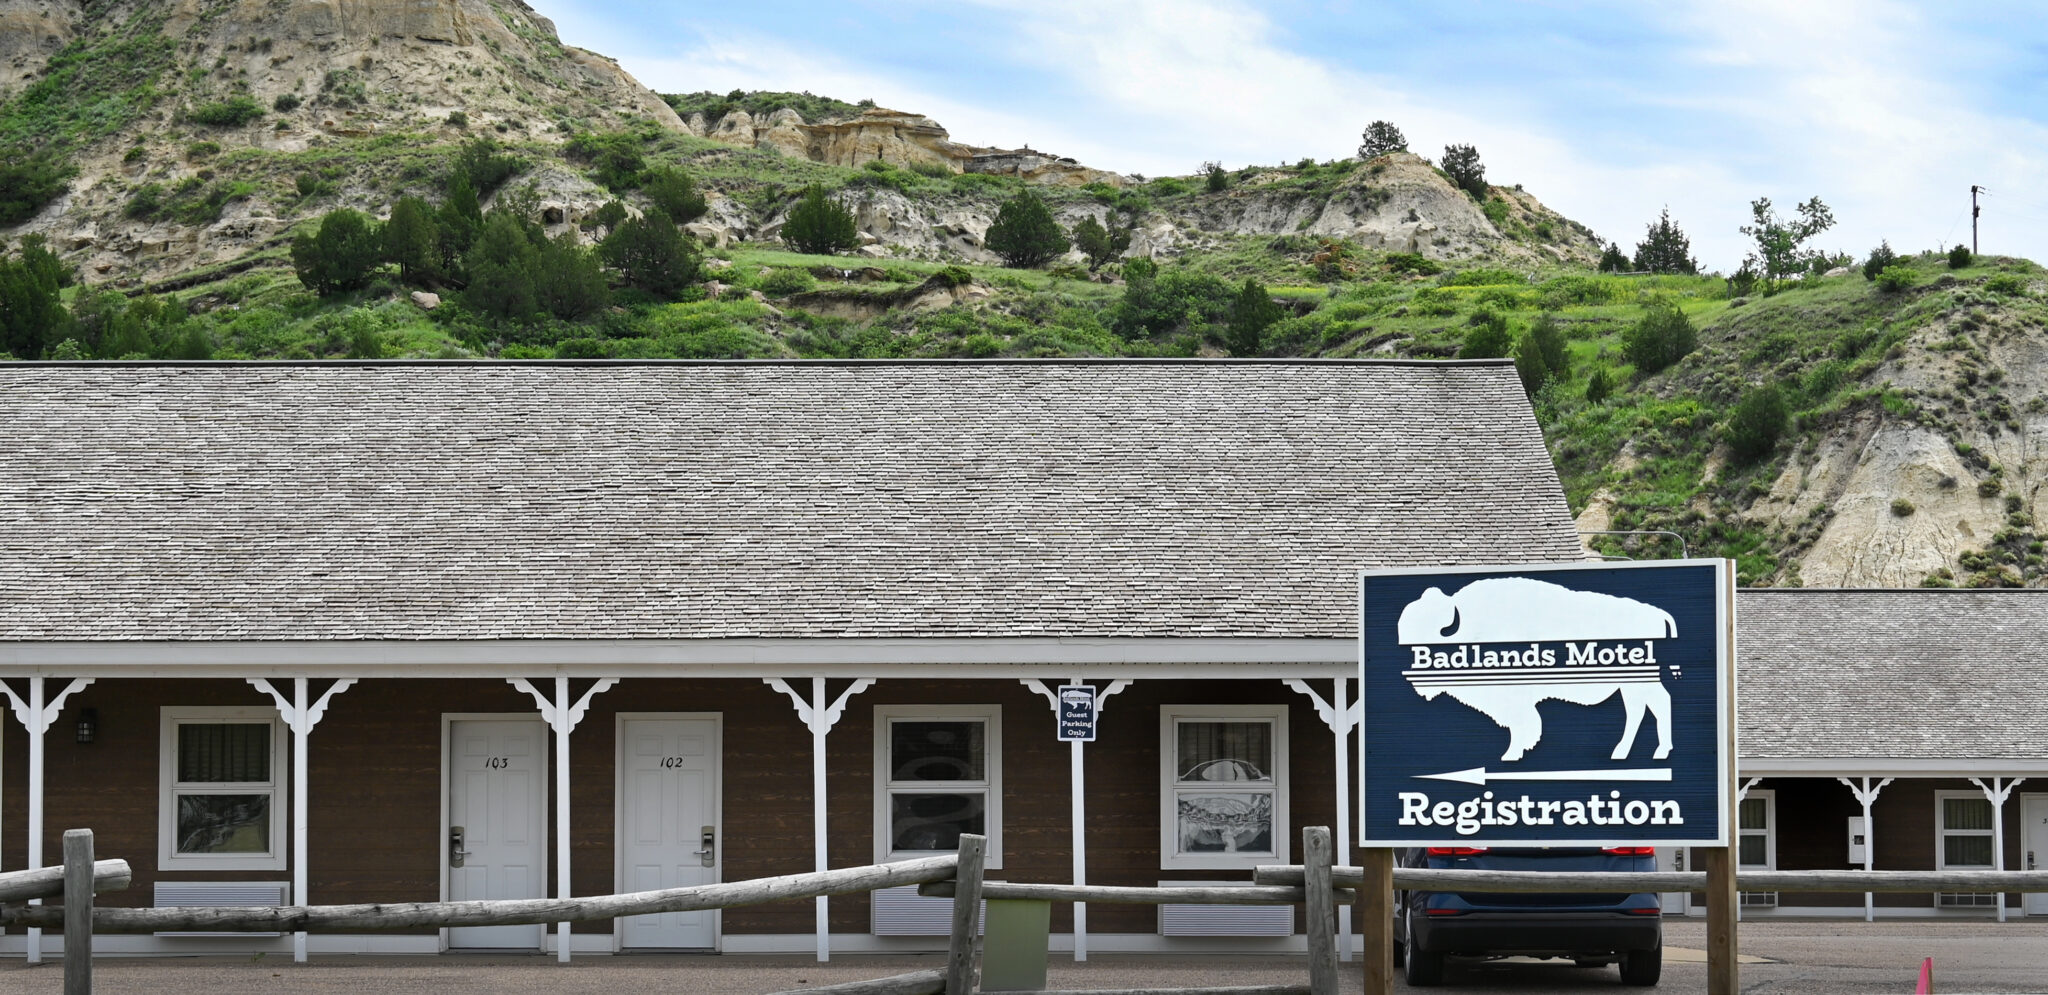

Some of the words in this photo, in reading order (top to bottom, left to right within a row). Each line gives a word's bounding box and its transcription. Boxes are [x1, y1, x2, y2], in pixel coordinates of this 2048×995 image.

[1411, 643, 1556, 669] Badlands
[1565, 640, 1656, 665] Motel
[485, 757, 509, 770] 103
[659, 757, 683, 770] 102
[1398, 790, 1684, 835] Registration
